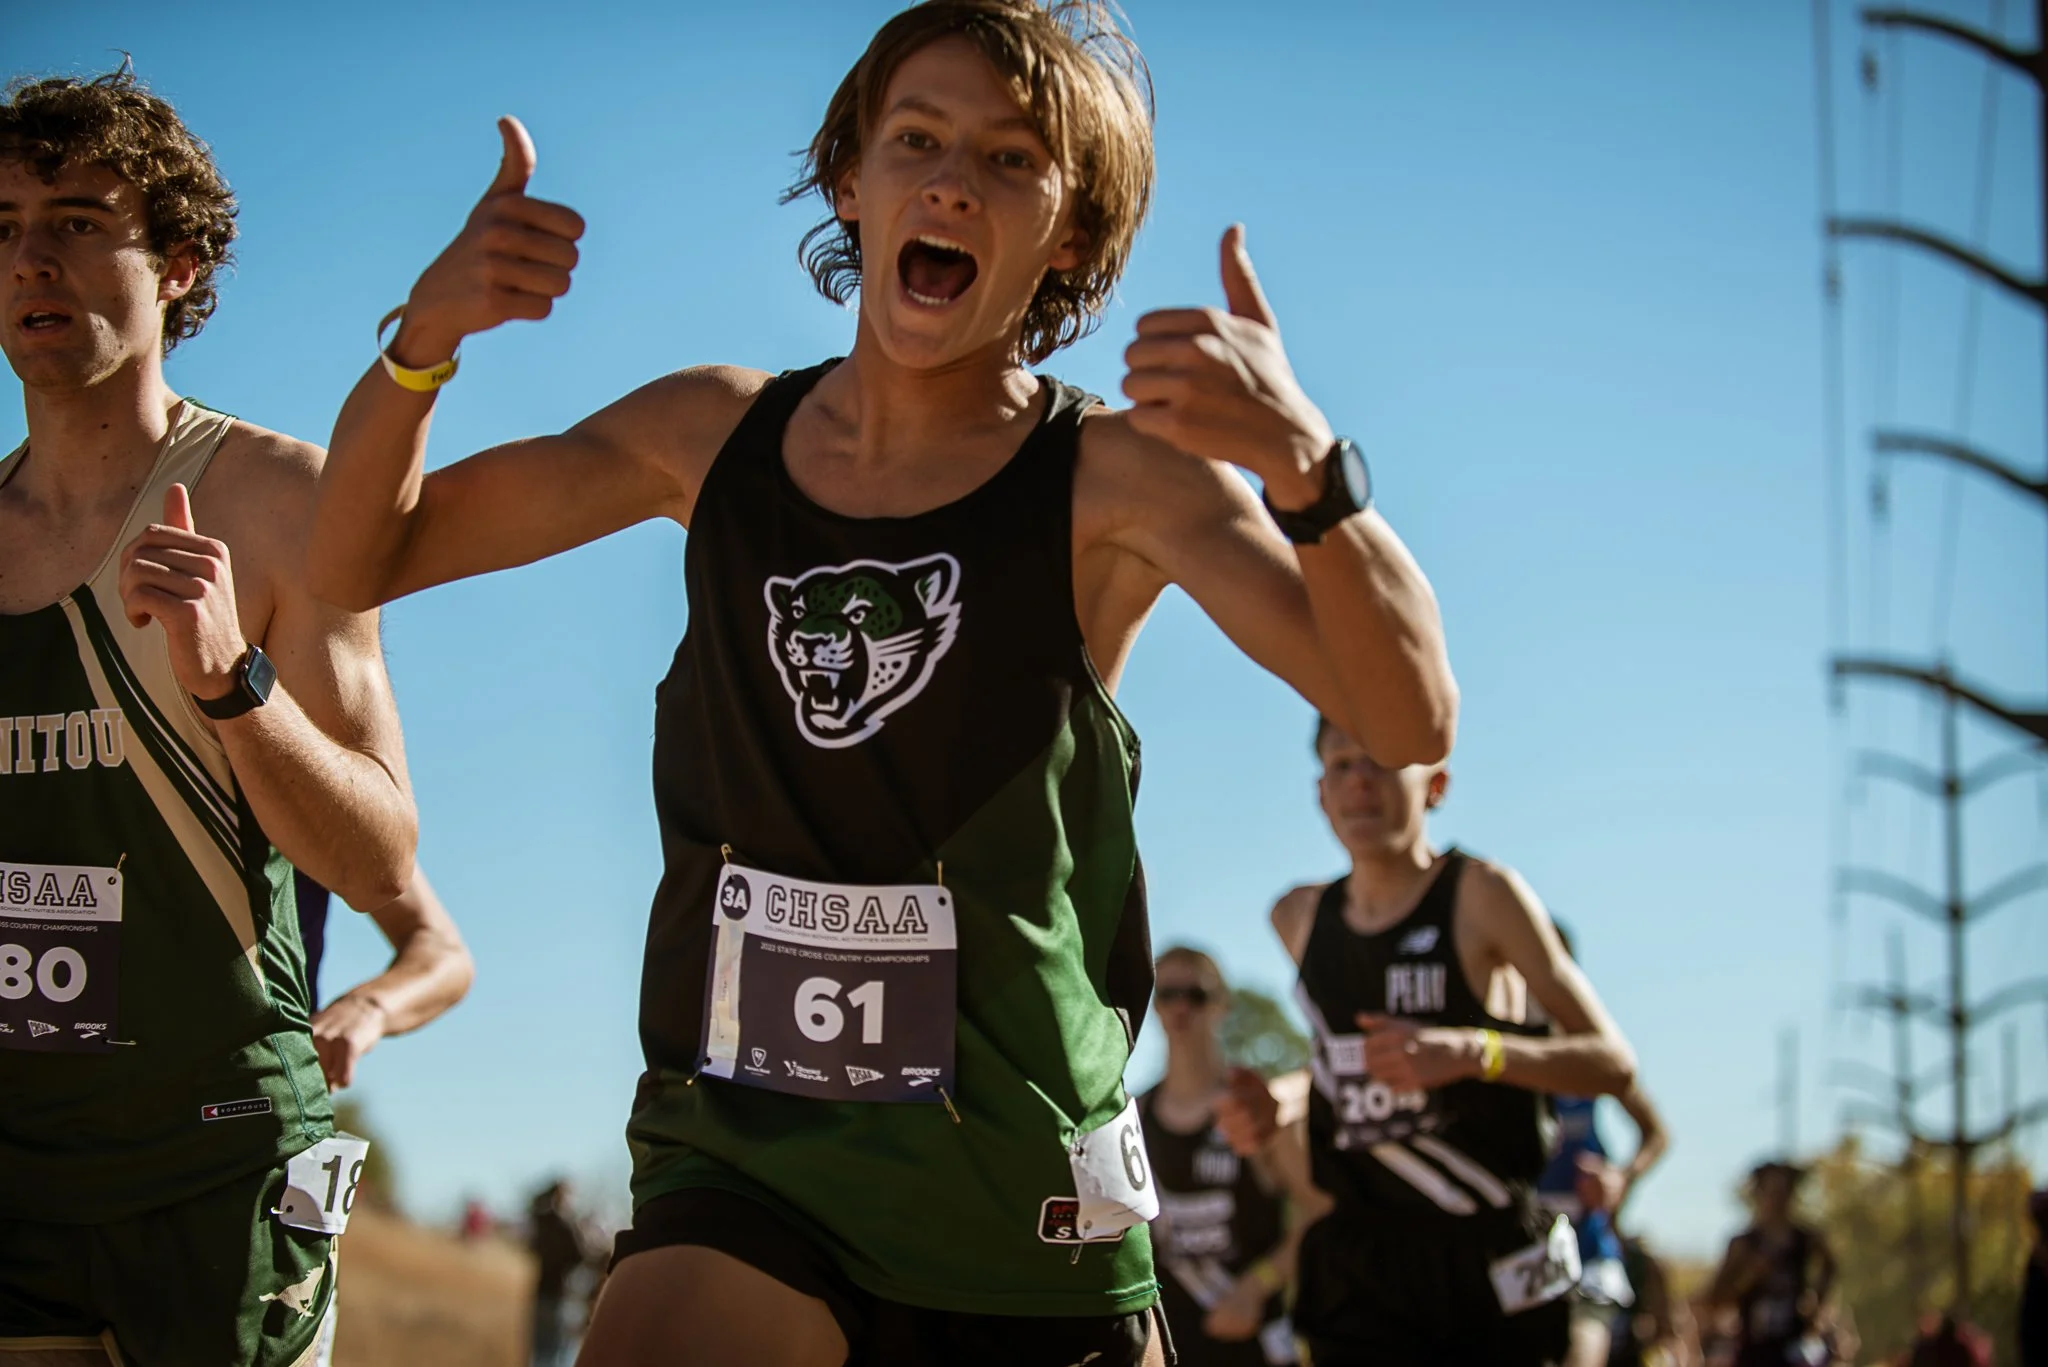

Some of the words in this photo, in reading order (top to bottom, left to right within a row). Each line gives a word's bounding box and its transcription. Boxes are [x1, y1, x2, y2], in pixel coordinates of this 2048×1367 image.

[0, 870, 98, 908] SAA
[722, 888, 748, 911] 3A
[765, 884, 929, 935] CHSAA
[10, 922, 41, 931] COUNTRY
[42, 924, 98, 932] CHAMPIONSHIPS
[777, 945, 798, 956] STATE
[799, 949, 823, 960] CROSS
[824, 952, 862, 963] COUNTRY
[864, 954, 930, 964] CHAMPIONSHIPS
[794, 976, 885, 1044] 61
[74, 1022, 107, 1030] BROOKS
[901, 1067, 941, 1077] BROOKS
[1120, 1113, 1147, 1191] 6
